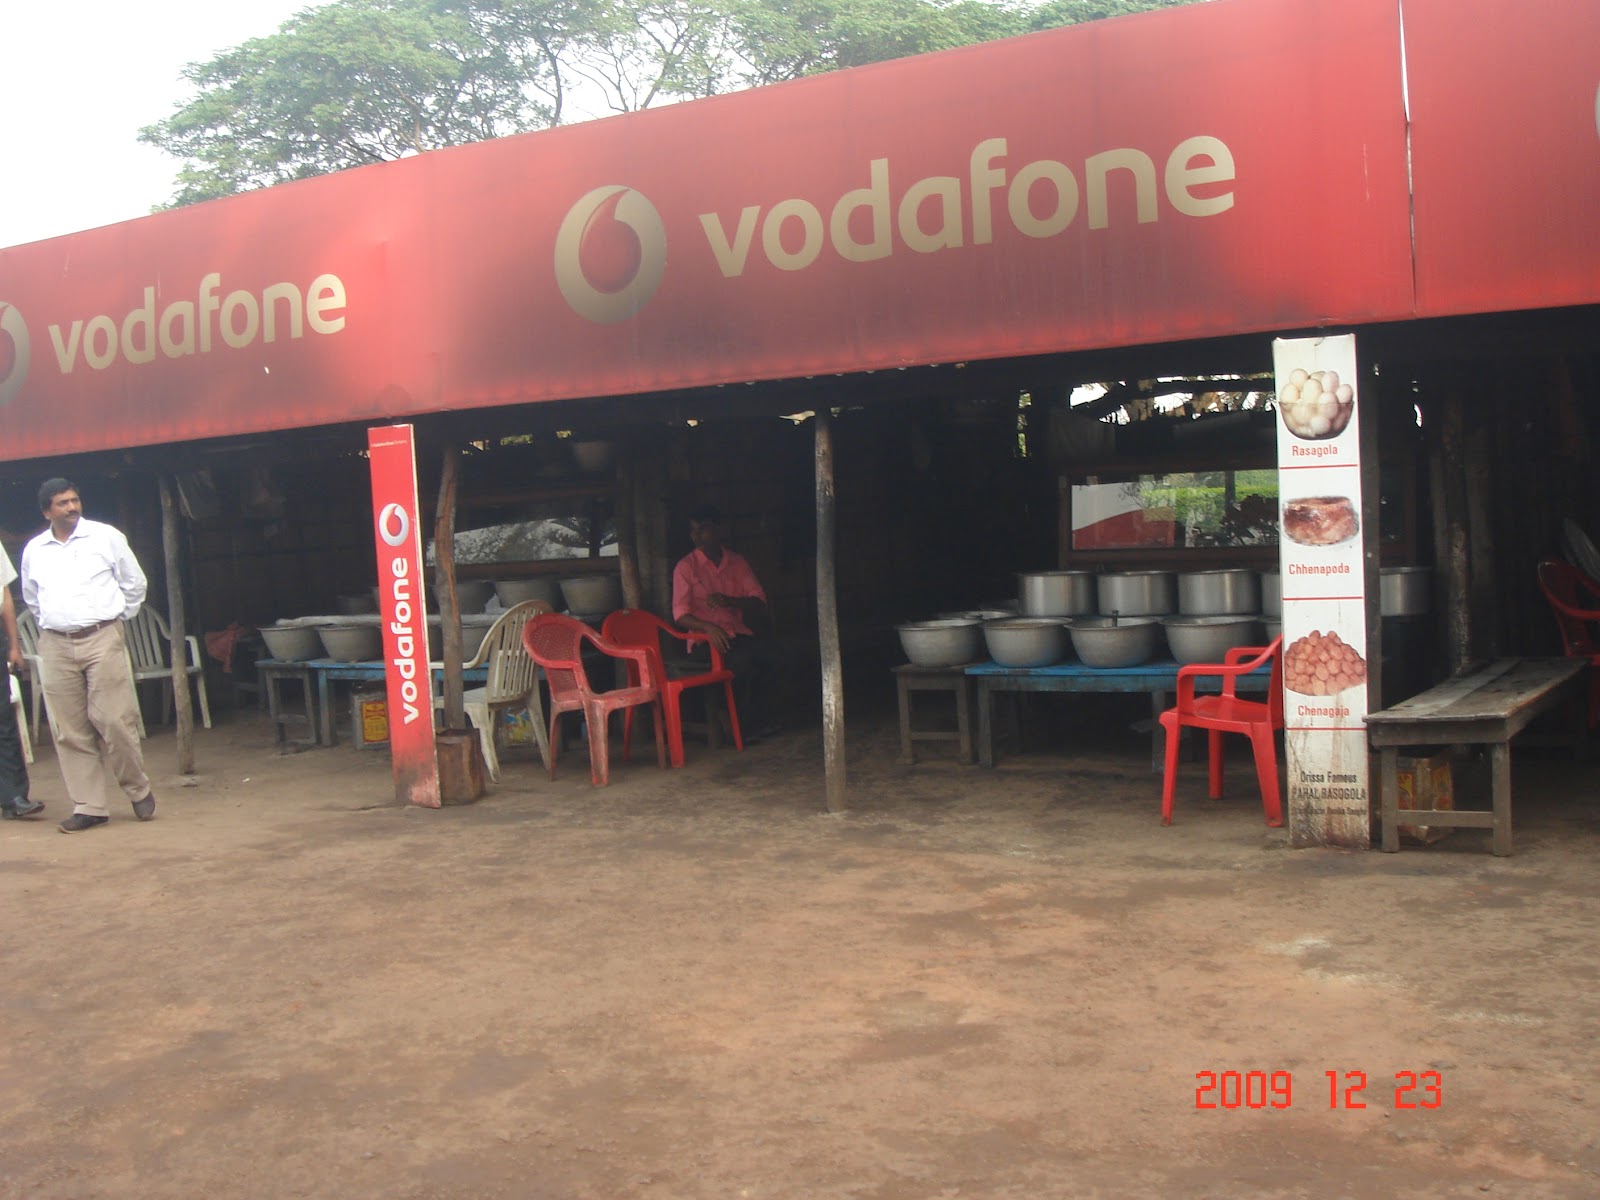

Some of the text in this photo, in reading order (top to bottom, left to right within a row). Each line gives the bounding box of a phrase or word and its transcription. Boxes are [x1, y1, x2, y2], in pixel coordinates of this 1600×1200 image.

[699, 135, 1236, 278] vodafone
[47, 271, 348, 375] vodafone
[1292, 444, 1338, 457] Rasagola
[1289, 563, 1350, 576] Chhenapoda
[391, 557, 420, 725] vodafone
[1298, 705, 1349, 718] Chenagaja
[1301, 771, 1357, 783] Orissa Famous
